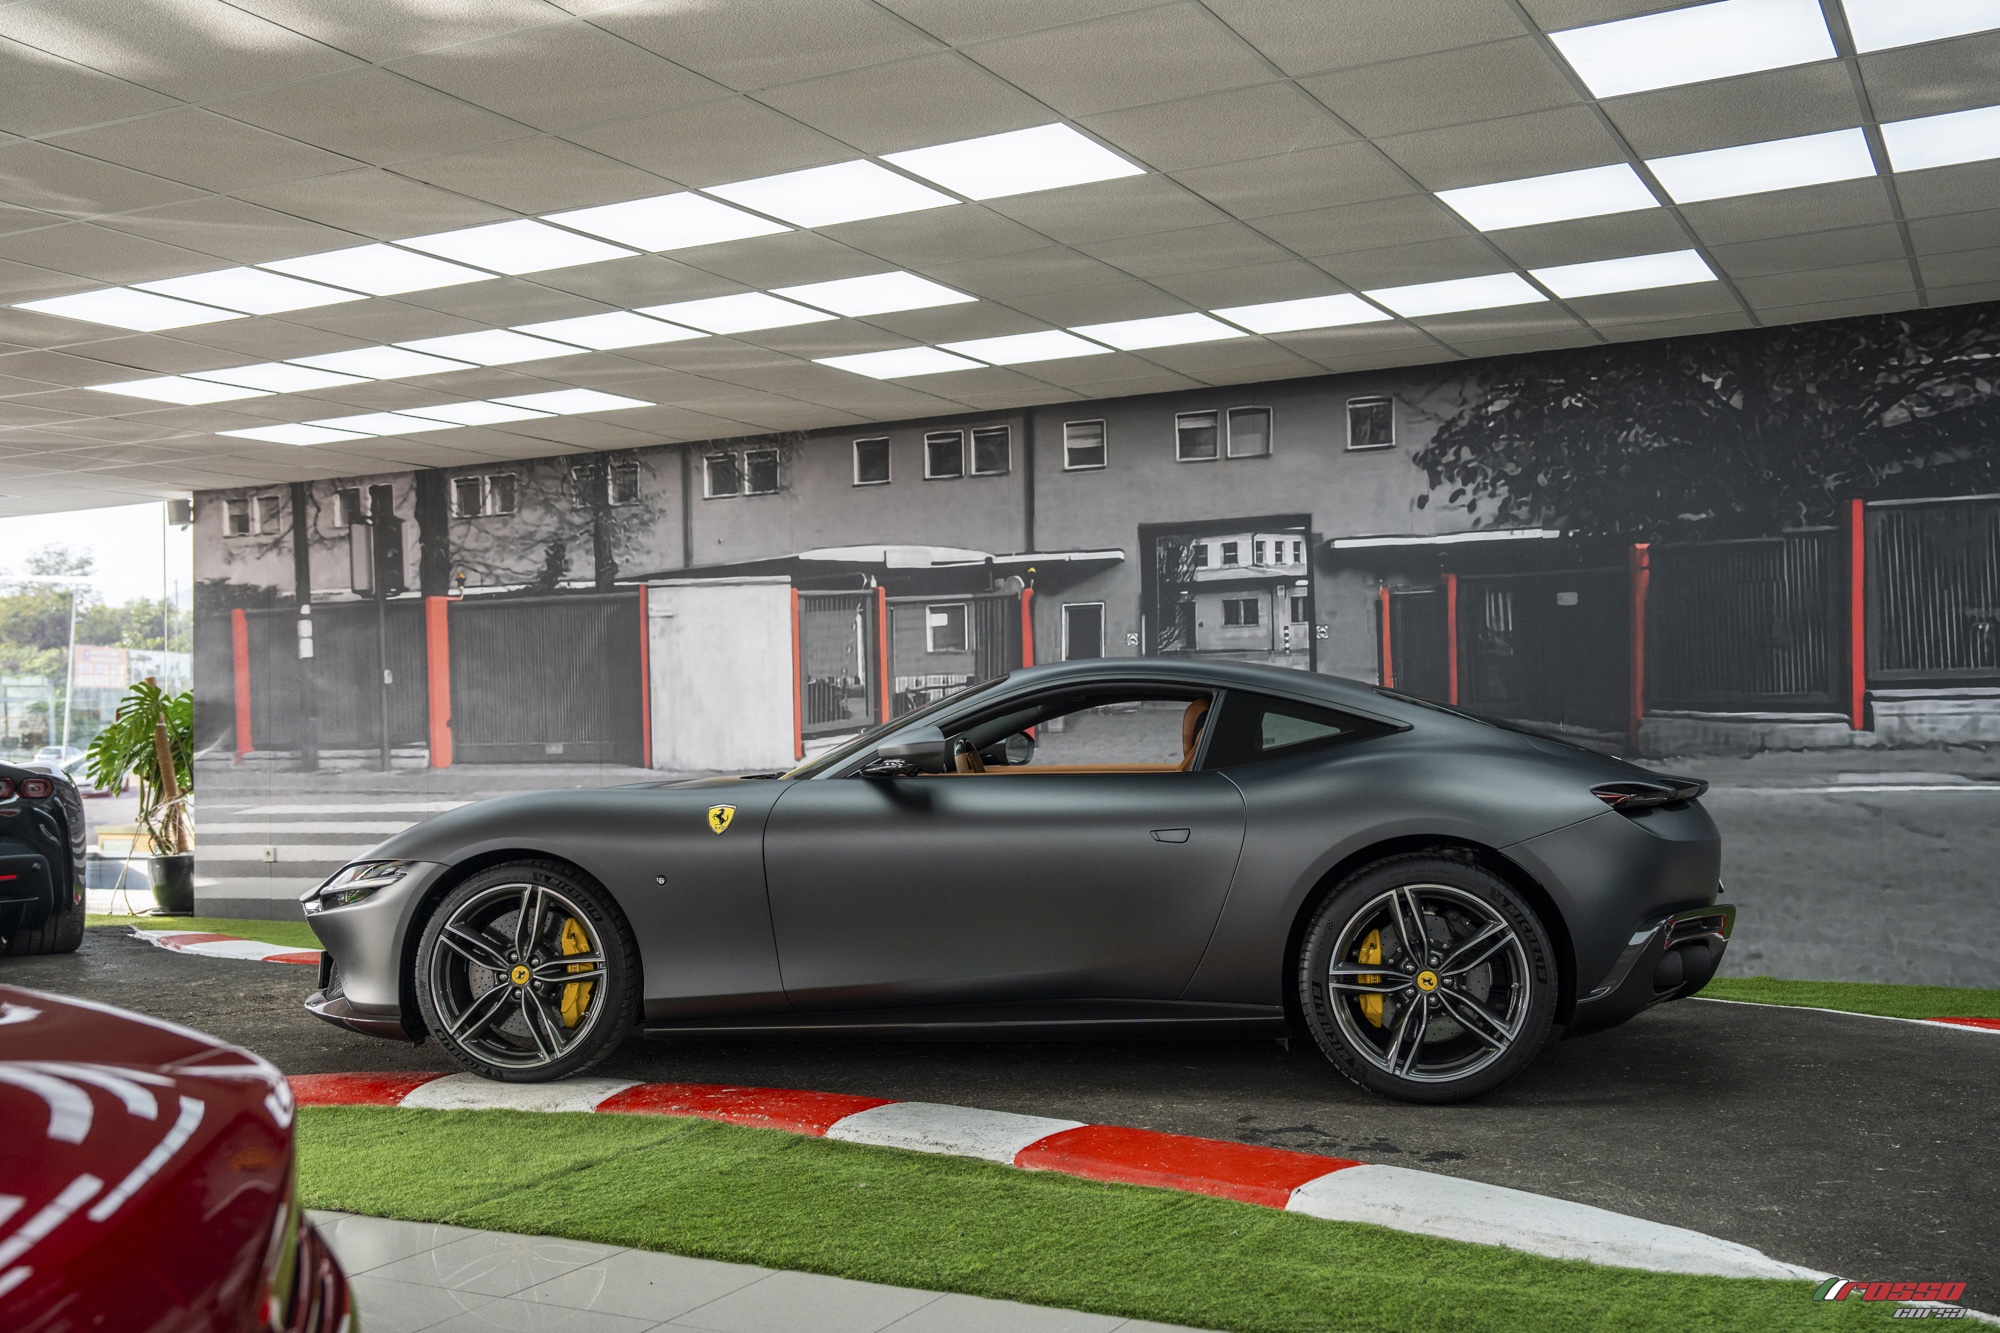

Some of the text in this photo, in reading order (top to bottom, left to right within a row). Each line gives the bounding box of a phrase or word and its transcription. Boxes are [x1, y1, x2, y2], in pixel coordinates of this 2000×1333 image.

[548, 876, 601, 921] MICHELIN
[1506, 904, 1546, 981] MICHELIN
[1312, 984, 1351, 1061] MICHELIN
[437, 1031, 491, 1076] MICHELIN
